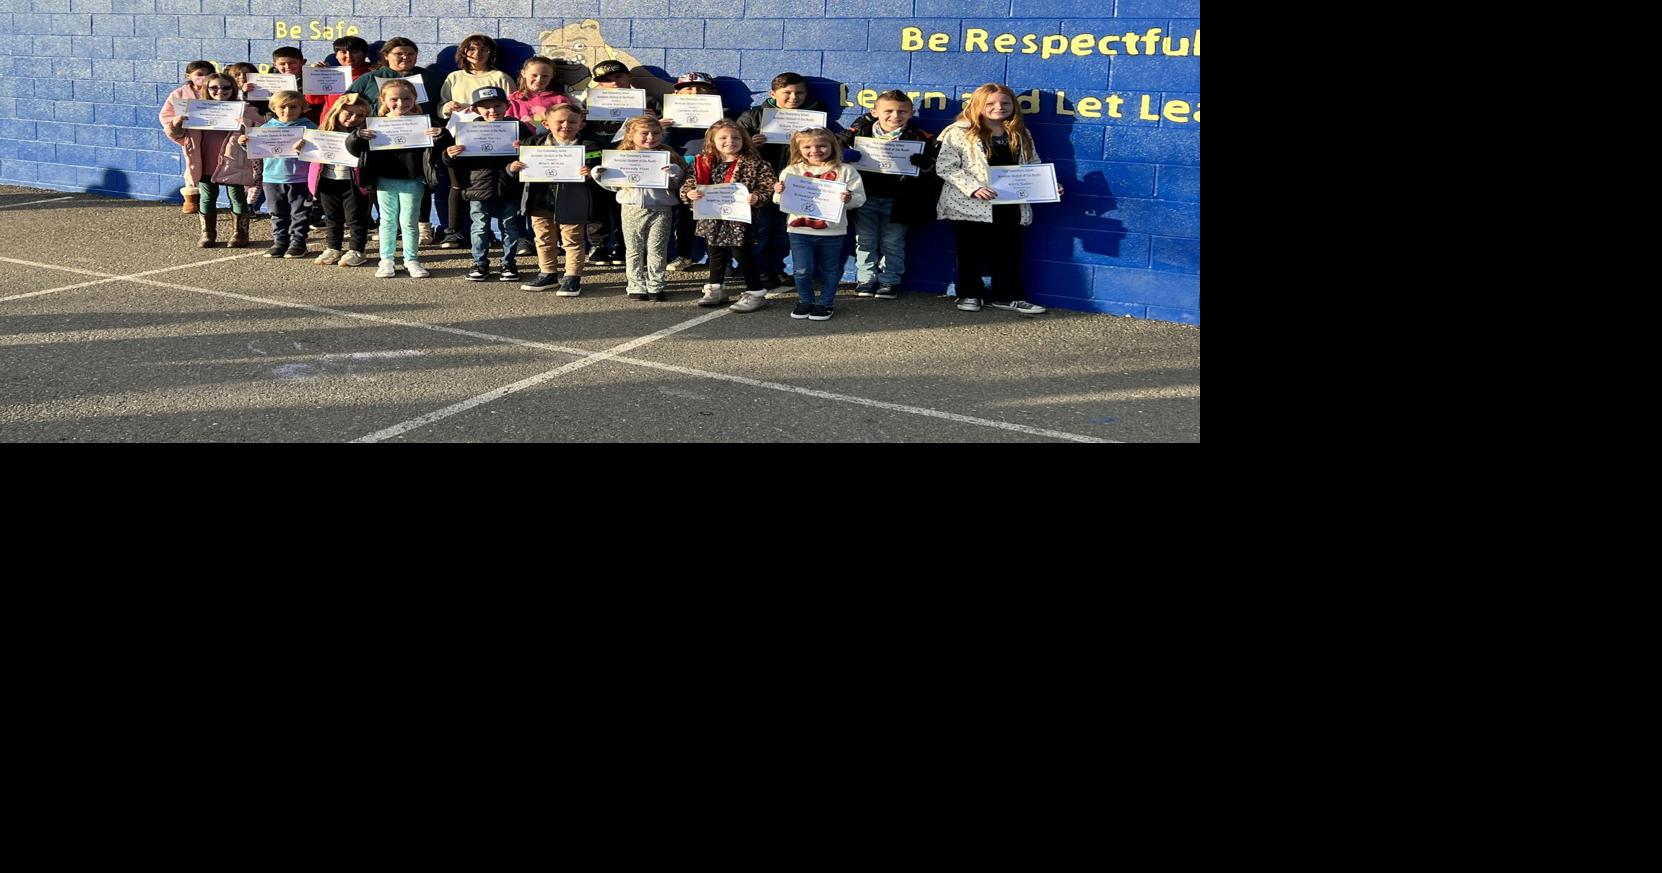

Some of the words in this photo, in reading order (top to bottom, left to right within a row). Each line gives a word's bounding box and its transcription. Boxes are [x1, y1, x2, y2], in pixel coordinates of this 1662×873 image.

[276, 21, 302, 39] Be
[309, 20, 360, 40] Safe
[901, 27, 949, 52] Be
[965, 28, 1200, 60] Respectful
[1056, 91, 1125, 118] Let
